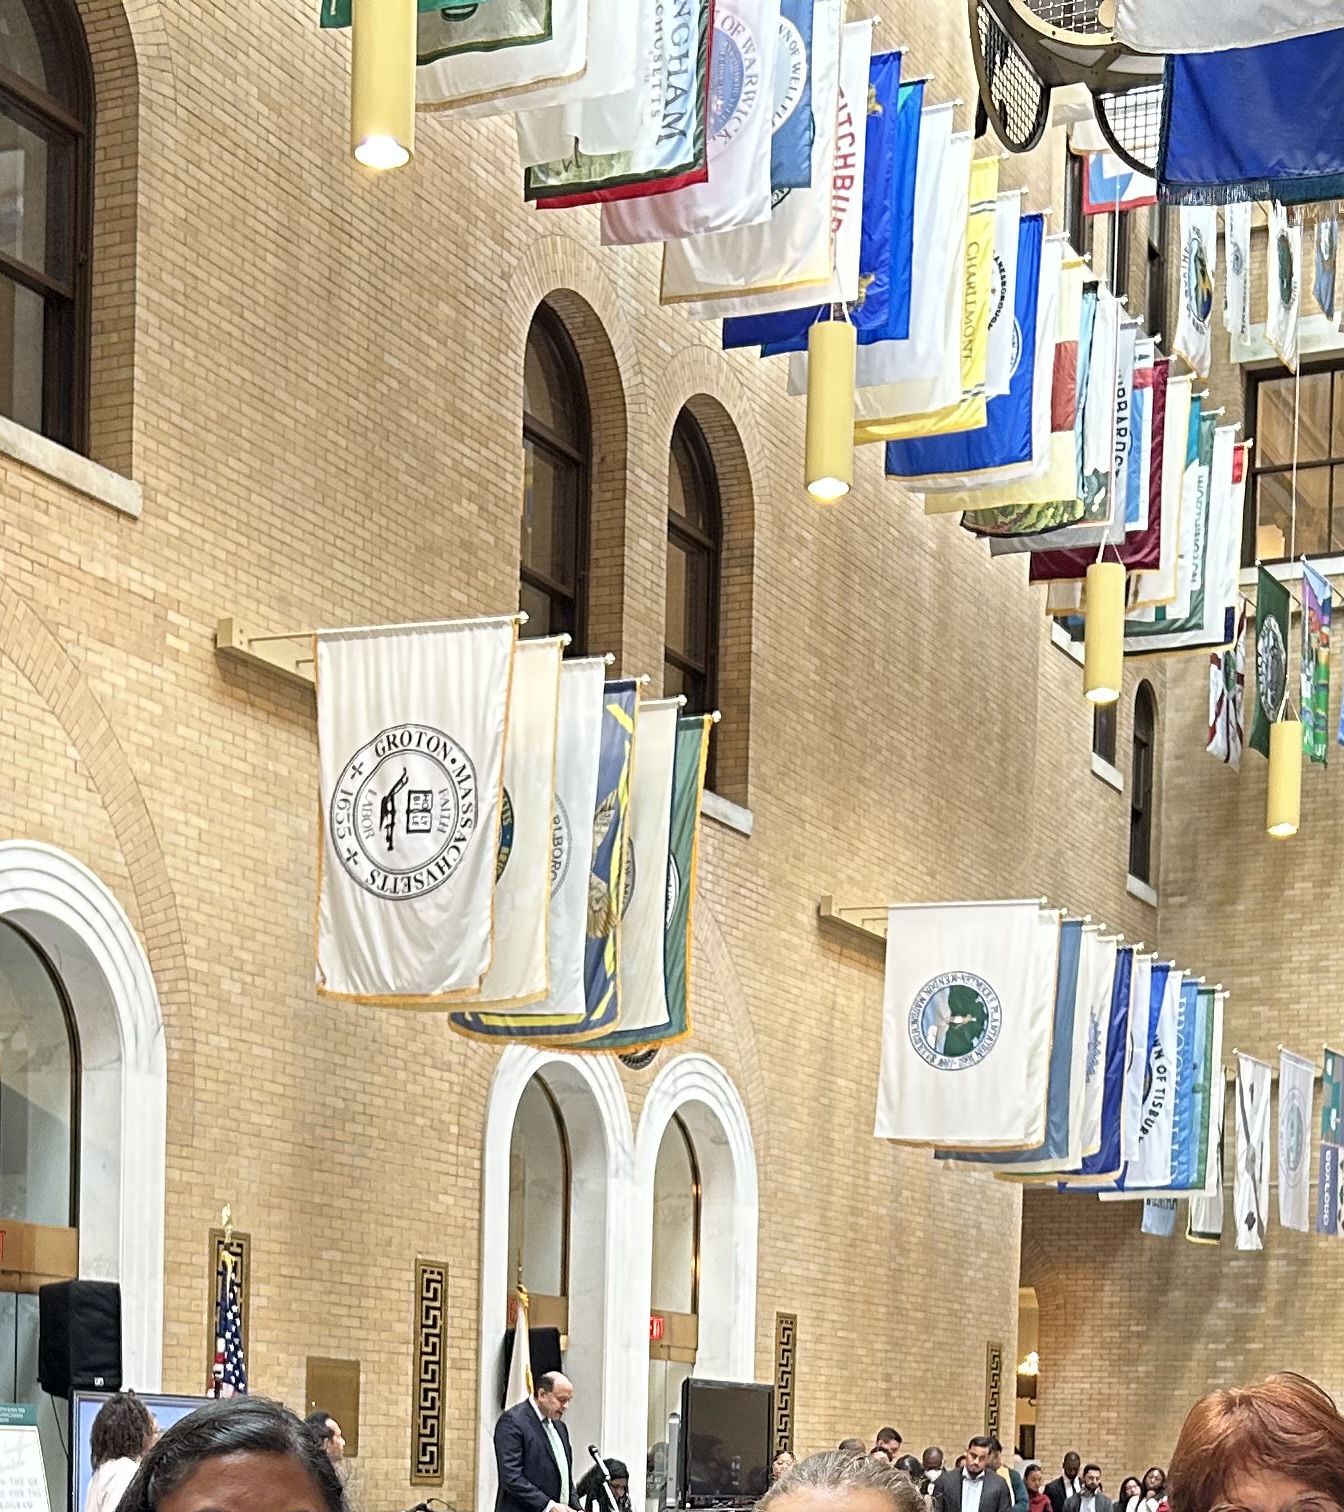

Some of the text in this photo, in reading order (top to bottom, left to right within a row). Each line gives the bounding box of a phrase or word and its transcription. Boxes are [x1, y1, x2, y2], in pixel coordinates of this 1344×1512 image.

[721, 15, 743, 38] OF
[374, 730, 454, 762] GROTON
[335, 788, 354, 840] 1655
[360, 788, 378, 840] LABOR
[438, 788, 451, 834] FAITH
[1156, 1065, 1167, 1083] OF
